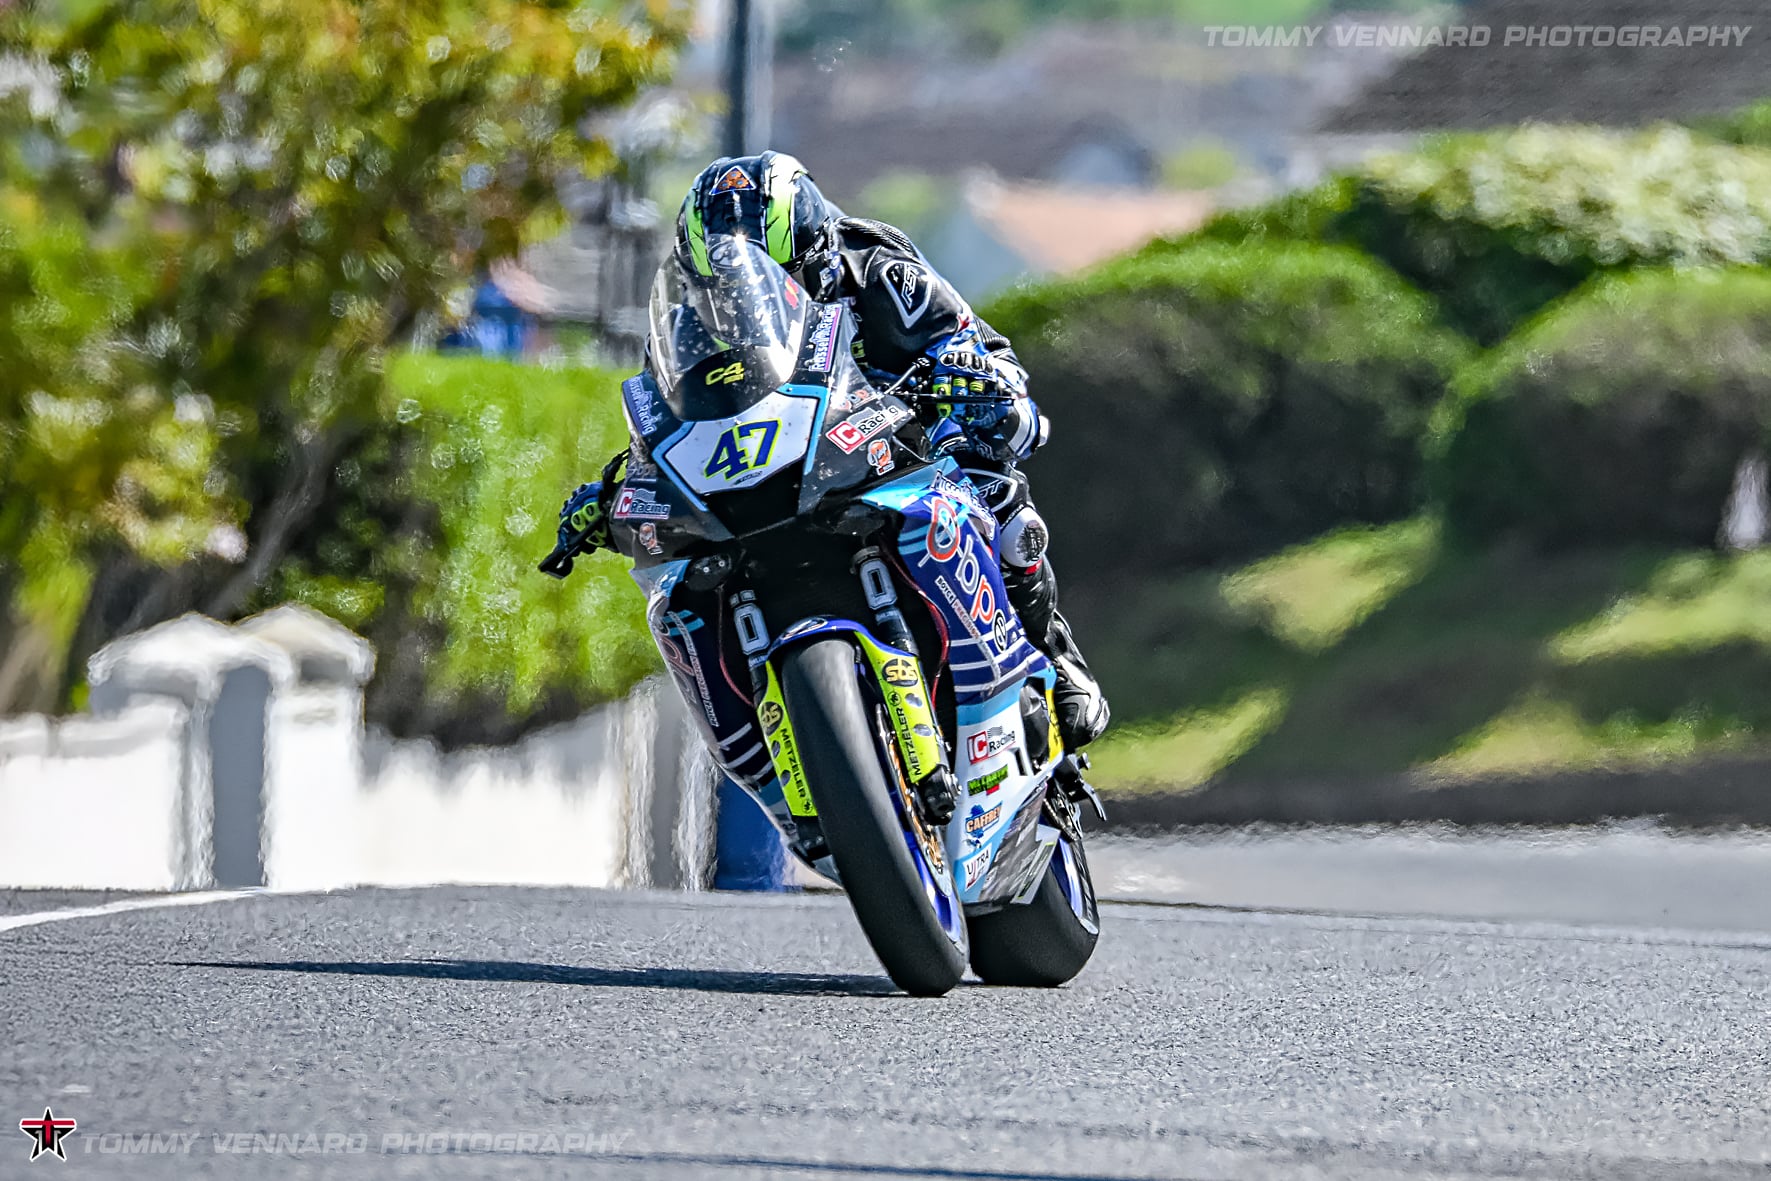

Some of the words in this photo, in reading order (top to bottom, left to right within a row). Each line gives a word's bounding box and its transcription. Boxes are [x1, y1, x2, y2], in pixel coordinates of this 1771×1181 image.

[704, 418, 782, 481] 47
[780, 728, 807, 798] METZELER
[895, 707, 922, 776] METZELER
